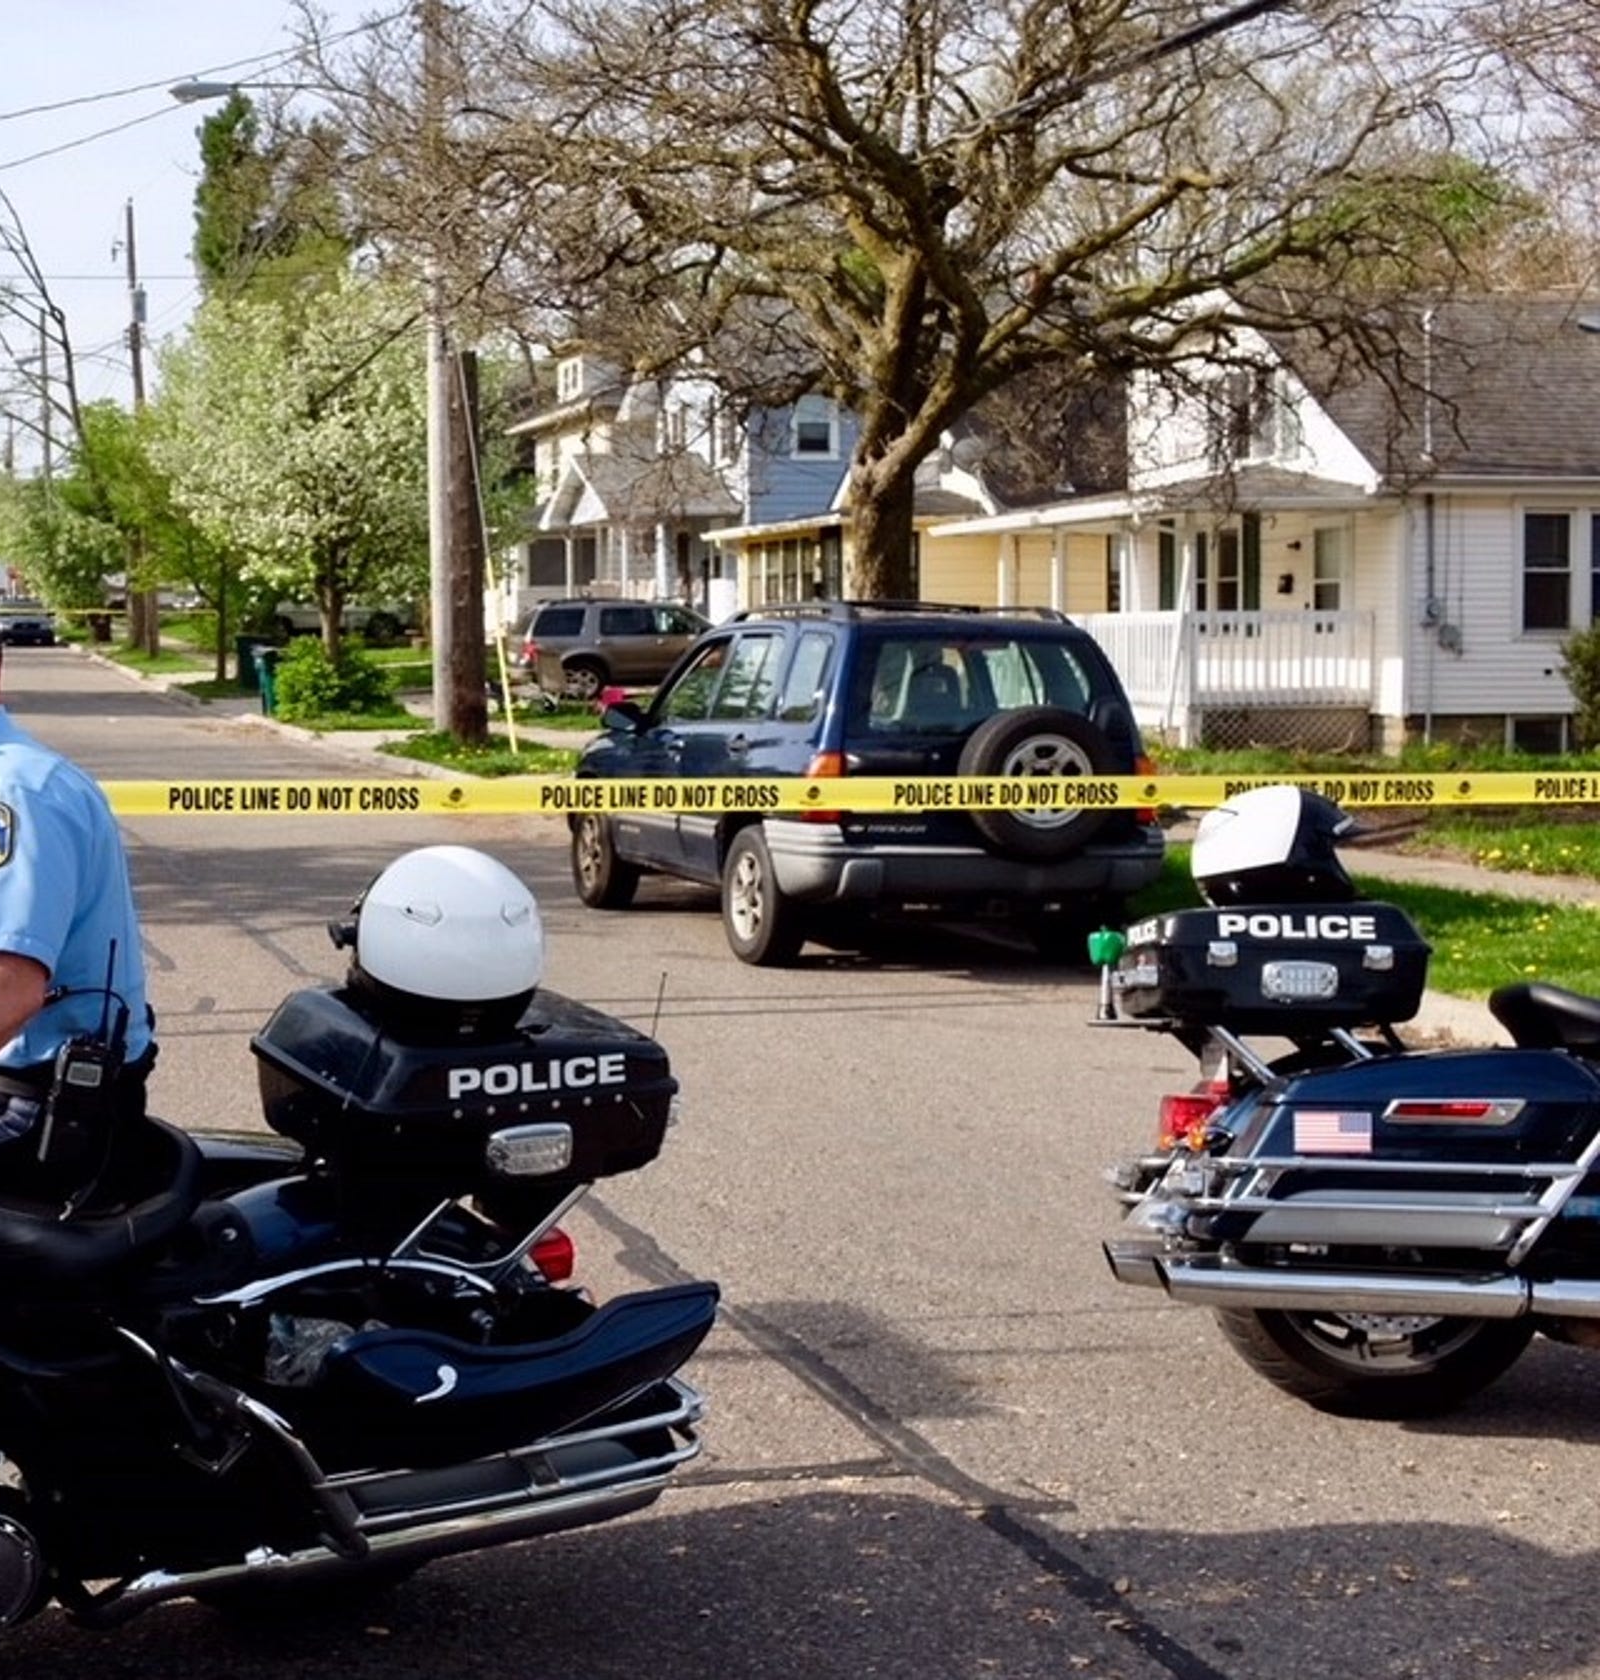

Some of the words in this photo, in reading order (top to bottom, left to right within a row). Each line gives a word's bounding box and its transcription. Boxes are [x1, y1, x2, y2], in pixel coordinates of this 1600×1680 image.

[169, 787, 234, 810] POLICE
[241, 787, 280, 810] LINE
[287, 787, 311, 810] DO
[318, 787, 353, 810] NOT
[359, 787, 420, 810] CROSS
[541, 786, 603, 808] POLICE
[610, 786, 647, 808] LINE
[653, 785, 677, 808] DO
[683, 785, 716, 807] NOT
[722, 785, 780, 807] CROSS
[895, 784, 953, 806] POLICE
[959, 784, 994, 805] LINE
[1000, 784, 1023, 805] DO
[1027, 783, 1059, 804] NOT
[1065, 782, 1119, 804] CROSS
[1350, 780, 1381, 801] NOT
[1385, 780, 1434, 801] CROSS
[1534, 778, 1587, 799] POLICE
[1217, 914, 1377, 940] POLICE
[448, 1053, 627, 1100] POLICE
